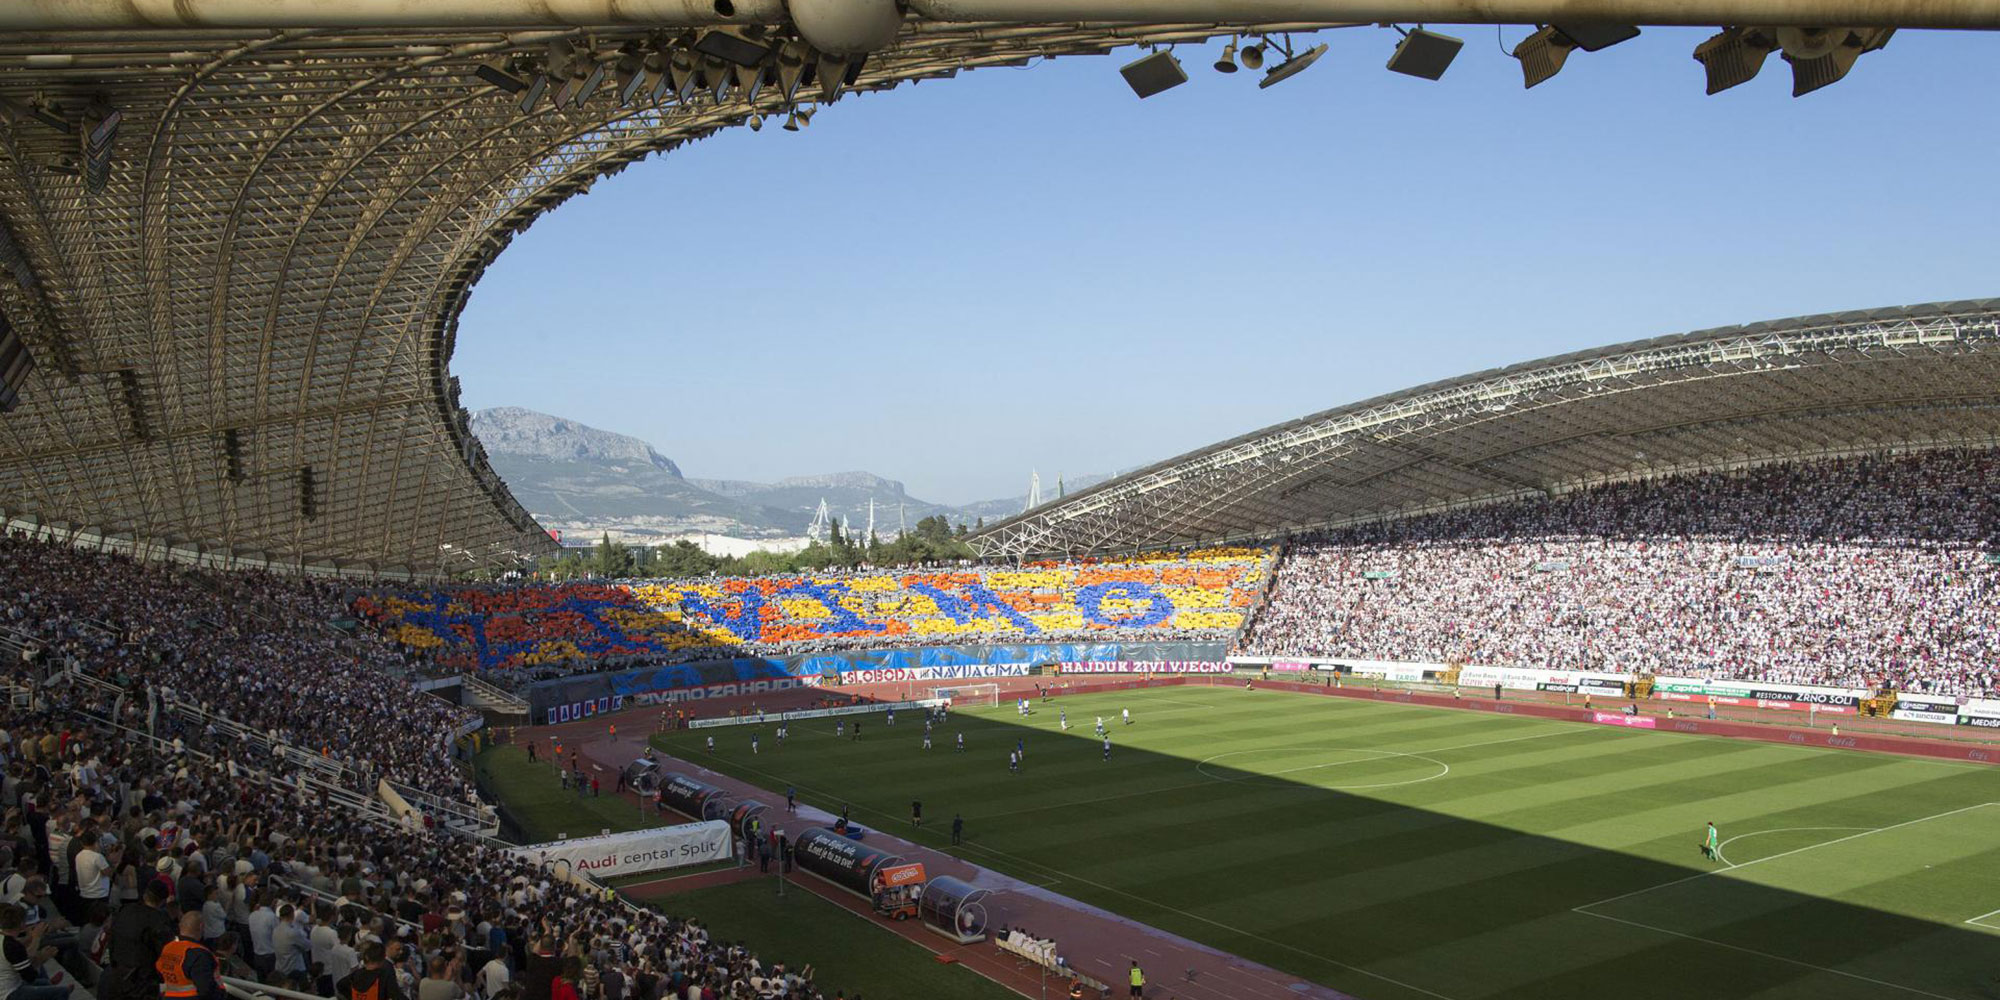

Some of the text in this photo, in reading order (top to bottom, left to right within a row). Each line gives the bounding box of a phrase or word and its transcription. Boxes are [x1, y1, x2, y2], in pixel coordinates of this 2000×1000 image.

[1061, 661, 1128, 673] HAJDUK
[848, 668, 916, 684] SLOBODA
[708, 684, 738, 699] ZA
[1756, 691, 1853, 706] RESTORAN ZRNO SOLI
[577, 840, 717, 872] Audi centar Split
